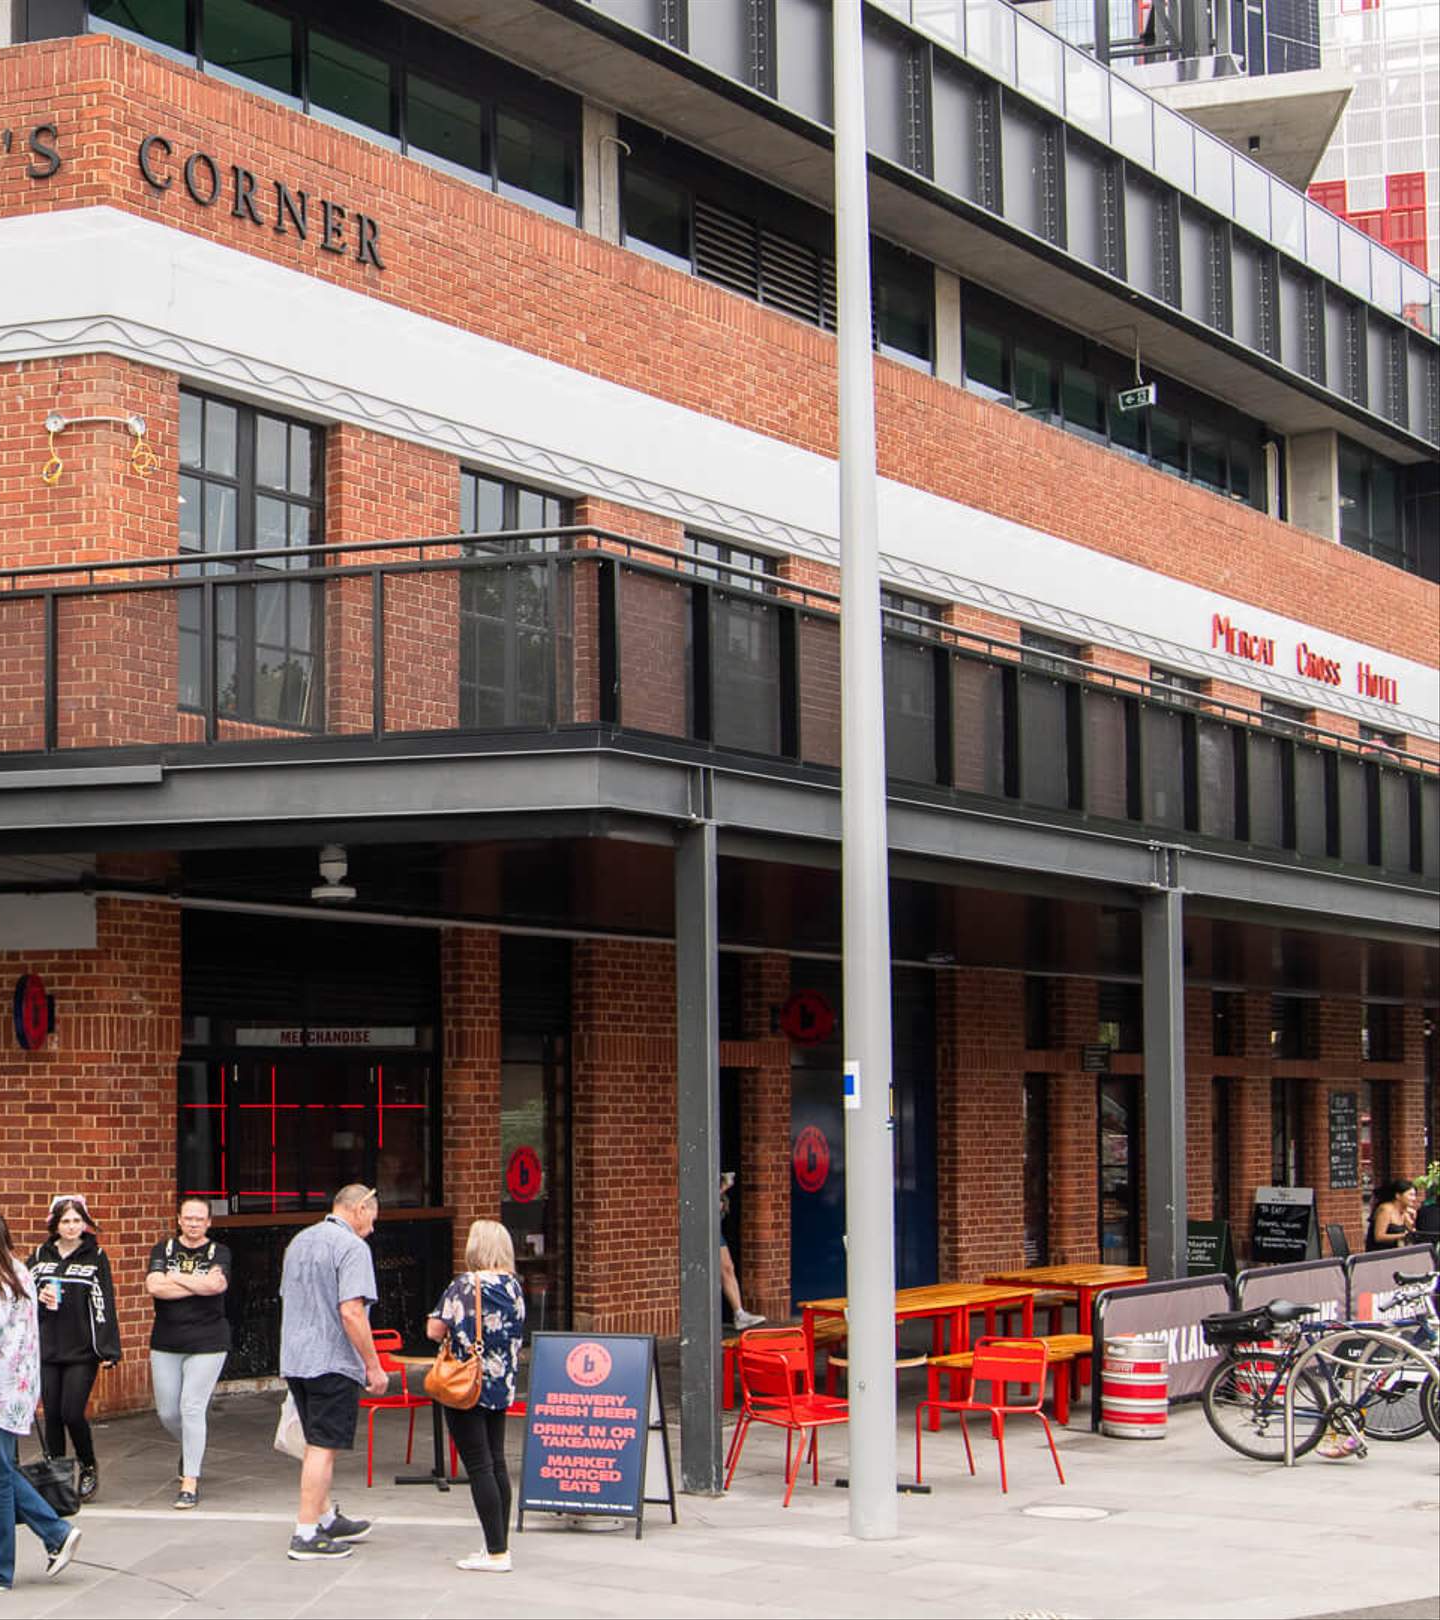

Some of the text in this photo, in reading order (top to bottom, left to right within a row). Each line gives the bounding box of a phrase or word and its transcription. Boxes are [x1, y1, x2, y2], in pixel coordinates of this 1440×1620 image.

[138, 133, 386, 270] CORNER
[1212, 613, 1399, 705] MERCAT CROSS HOTEL
[546, 1392, 627, 1407] BREWERY
[534, 1404, 638, 1420] FRESH BEER
[532, 1422, 636, 1439] DRINK IN OR
[540, 1435, 627, 1450] TAKEAWAY
[547, 1455, 617, 1469] MARKET
[540, 1466, 623, 1483] SOURCED
[559, 1480, 601, 1494] EATS
